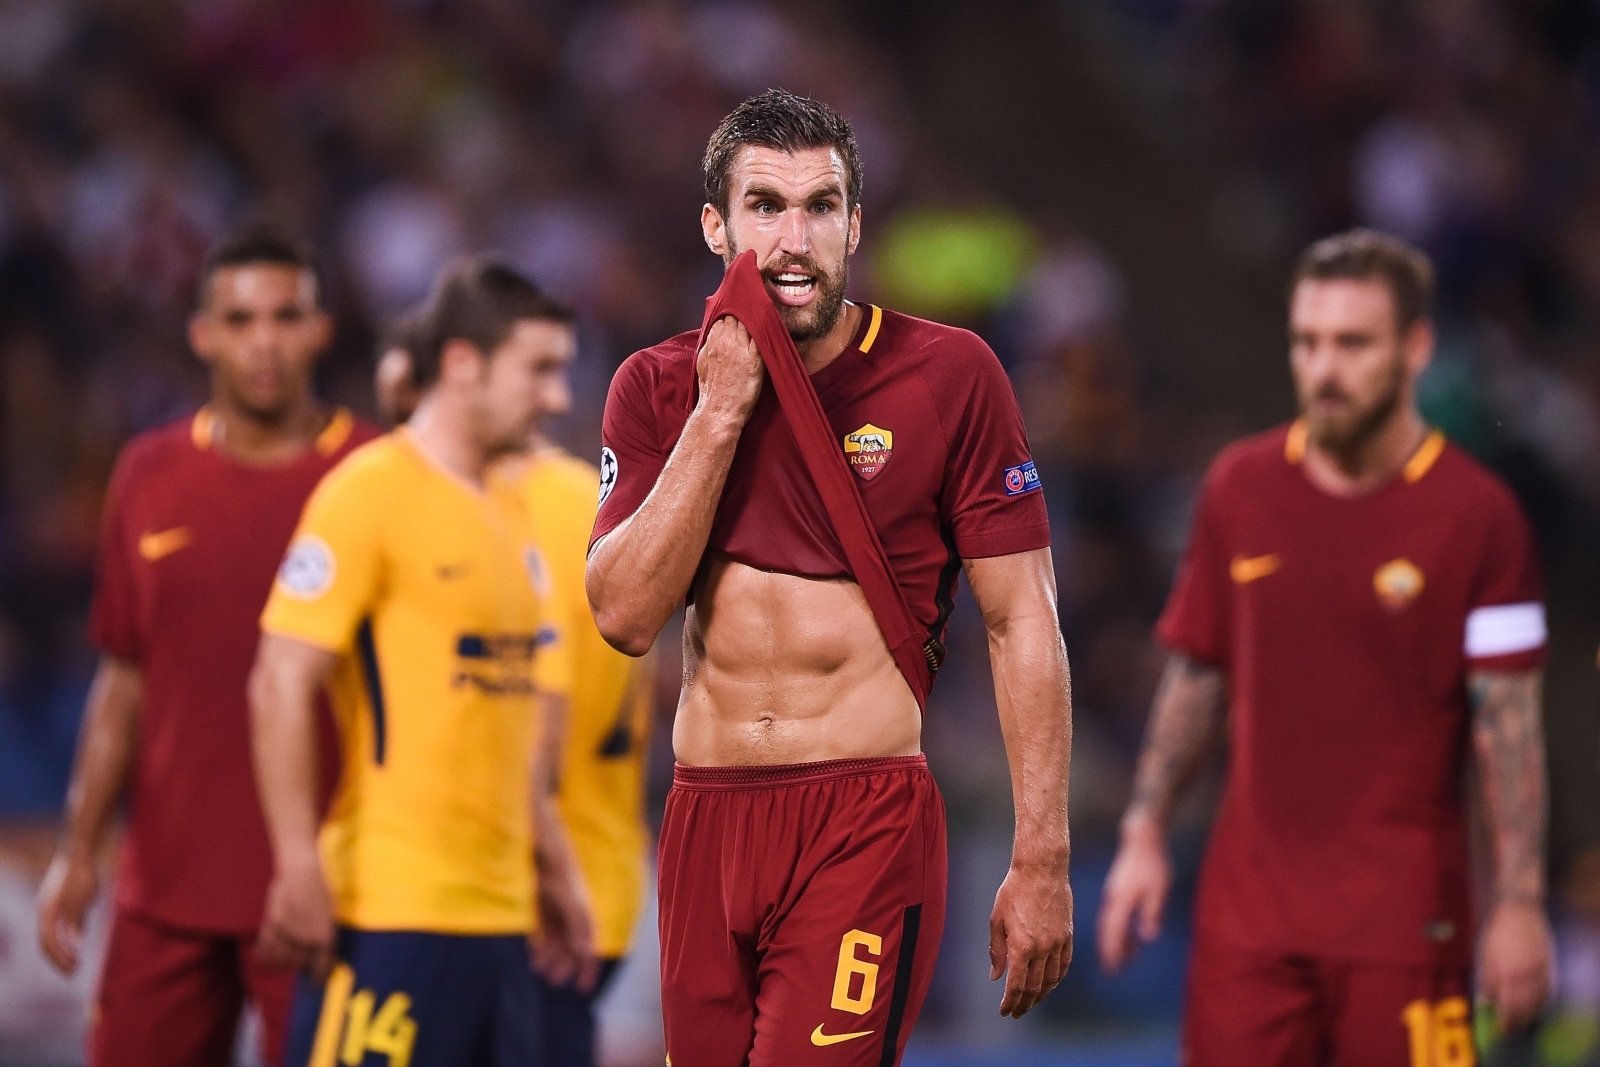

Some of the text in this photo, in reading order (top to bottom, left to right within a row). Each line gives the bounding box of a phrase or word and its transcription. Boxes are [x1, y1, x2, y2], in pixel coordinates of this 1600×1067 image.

[851, 454, 886, 465] ROMA
[831, 928, 882, 1016] 6
[342, 988, 418, 1067] 14
[1402, 997, 1476, 1067] 16
